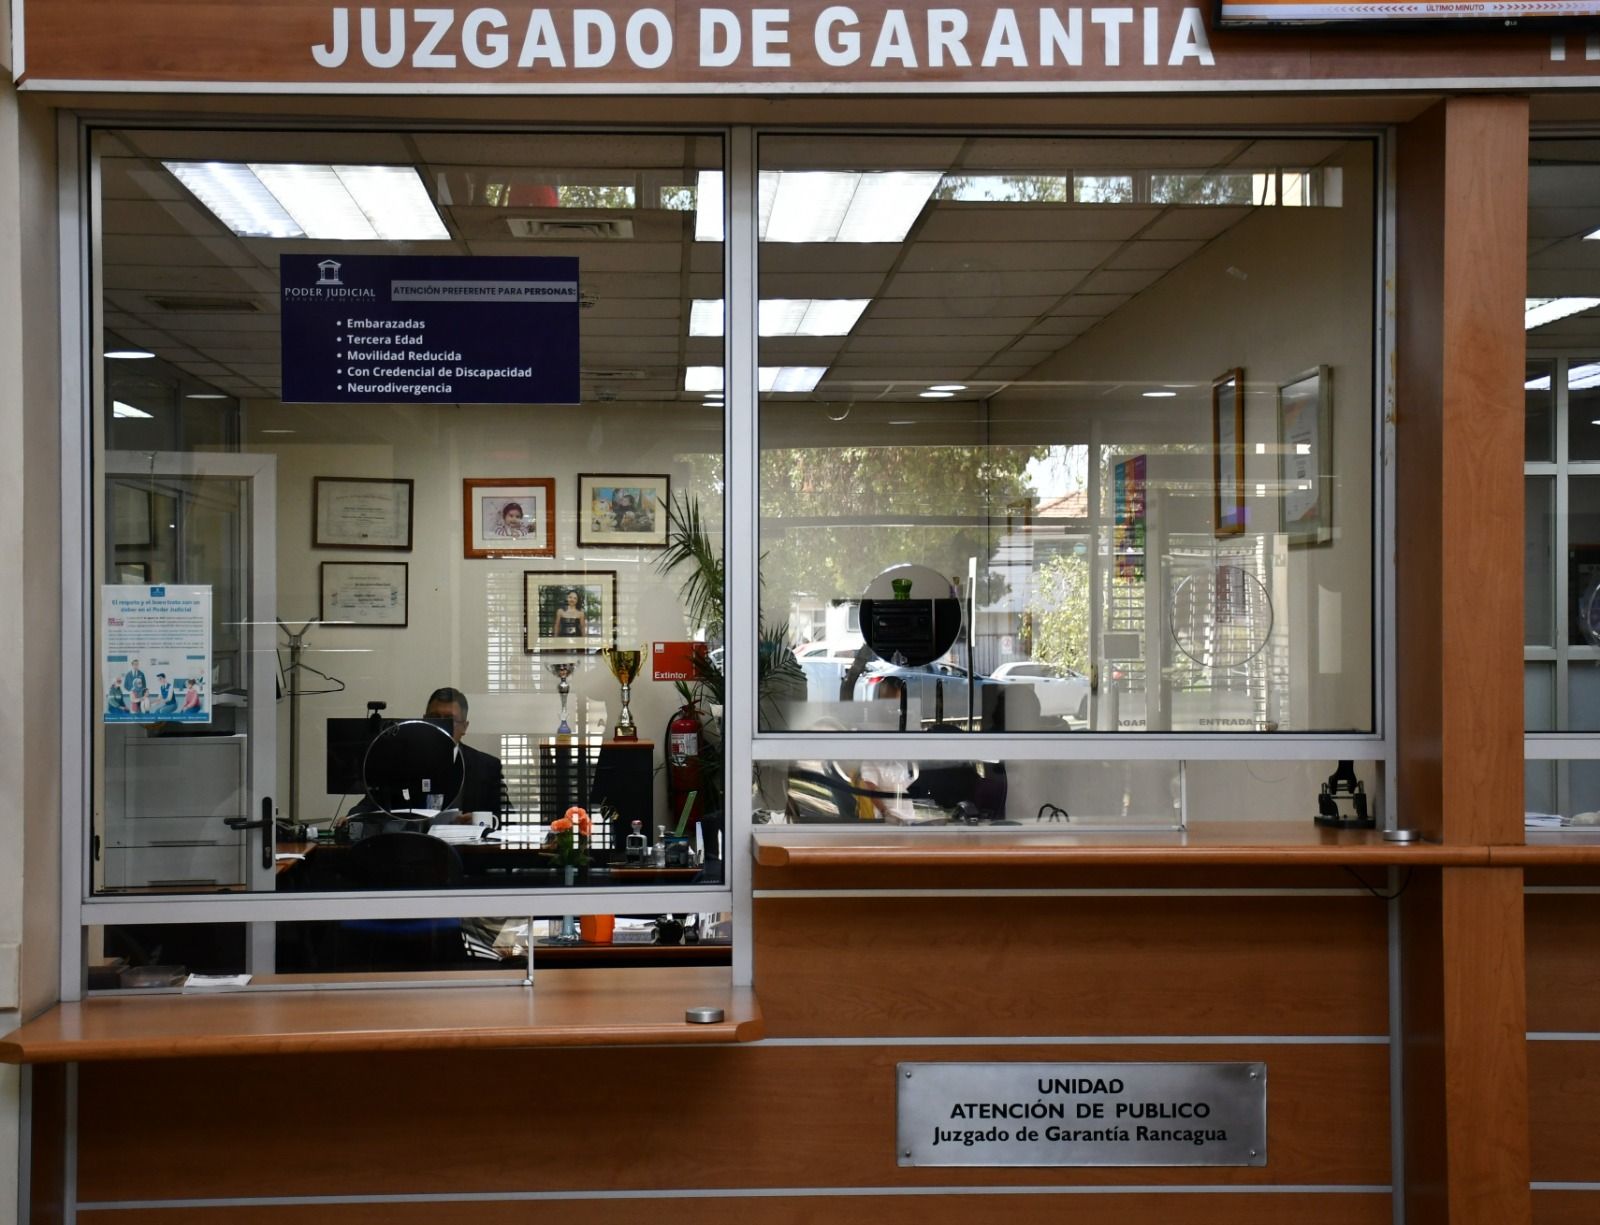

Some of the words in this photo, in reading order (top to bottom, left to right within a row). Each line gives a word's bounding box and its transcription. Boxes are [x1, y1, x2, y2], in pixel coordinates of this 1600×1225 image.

[311, 6, 674, 69] JUZGADO
[699, 7, 791, 68] DE
[814, 6, 1216, 69] GARANTIA
[284, 287, 323, 297] PODER
[326, 287, 376, 298] JUDICIAL
[393, 285, 441, 295] ATENCIÓN
[442, 286, 496, 296] PREFERENTE
[498, 287, 523, 295] PARA
[524, 287, 576, 296] PERSONAS:
[347, 318, 426, 329] Embarazadas
[347, 334, 392, 345] Tercera
[395, 334, 423, 345] Edad
[347, 350, 405, 361] Movilidad
[408, 350, 462, 361] Reducida
[347, 367, 370, 377] Con
[372, 366, 435, 377] Credencial
[437, 366, 453, 377] de
[455, 367, 532, 380] Discapacidad
[347, 382, 452, 396] Neurodivergencia
[654, 671, 688, 679] Extintor
[1199, 718, 1253, 726] ENTRADA
[1037, 1078, 1125, 1095] UNIDAD
[950, 1099, 1065, 1119] ATENCIÓN
[1076, 1103, 1105, 1119] DE
[1115, 1102, 1211, 1119] PUBLICO
[932, 1126, 1010, 1147] Juzgado
[1015, 1125, 1039, 1142] de
[1044, 1125, 1131, 1143] Garantía
[1136, 1127, 1228, 1146] Rancagua
